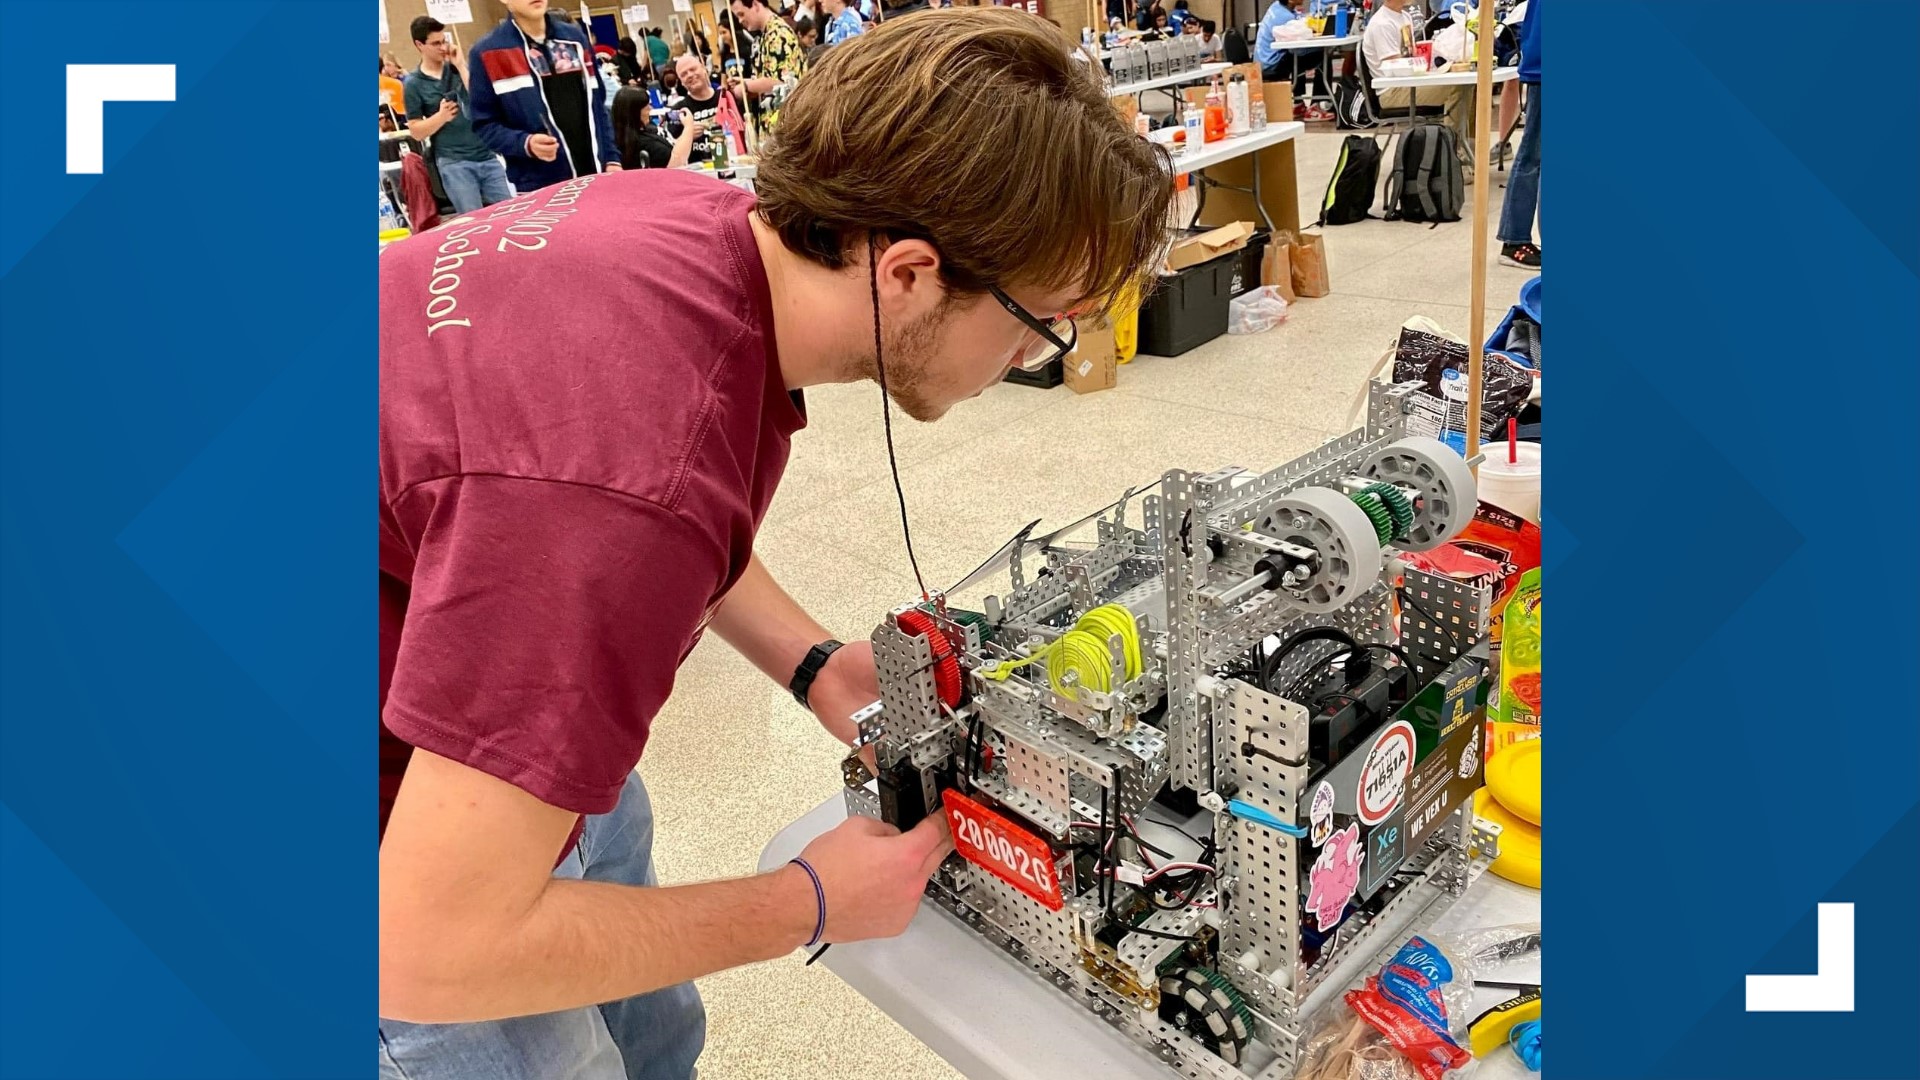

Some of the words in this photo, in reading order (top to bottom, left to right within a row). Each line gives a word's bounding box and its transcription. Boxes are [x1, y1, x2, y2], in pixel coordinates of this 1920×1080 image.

[426, 224, 492, 338] School
[1488, 511, 1516, 526] SIZE
[1366, 749, 1407, 800] 71651A
[1410, 814, 1424, 839] WE
[1425, 796, 1440, 824] VEX
[1442, 790, 1448, 808] U
[952, 809, 1053, 894] 20002G
[1376, 826, 1398, 856] Xe
[1496, 993, 1540, 1011] FatMax
